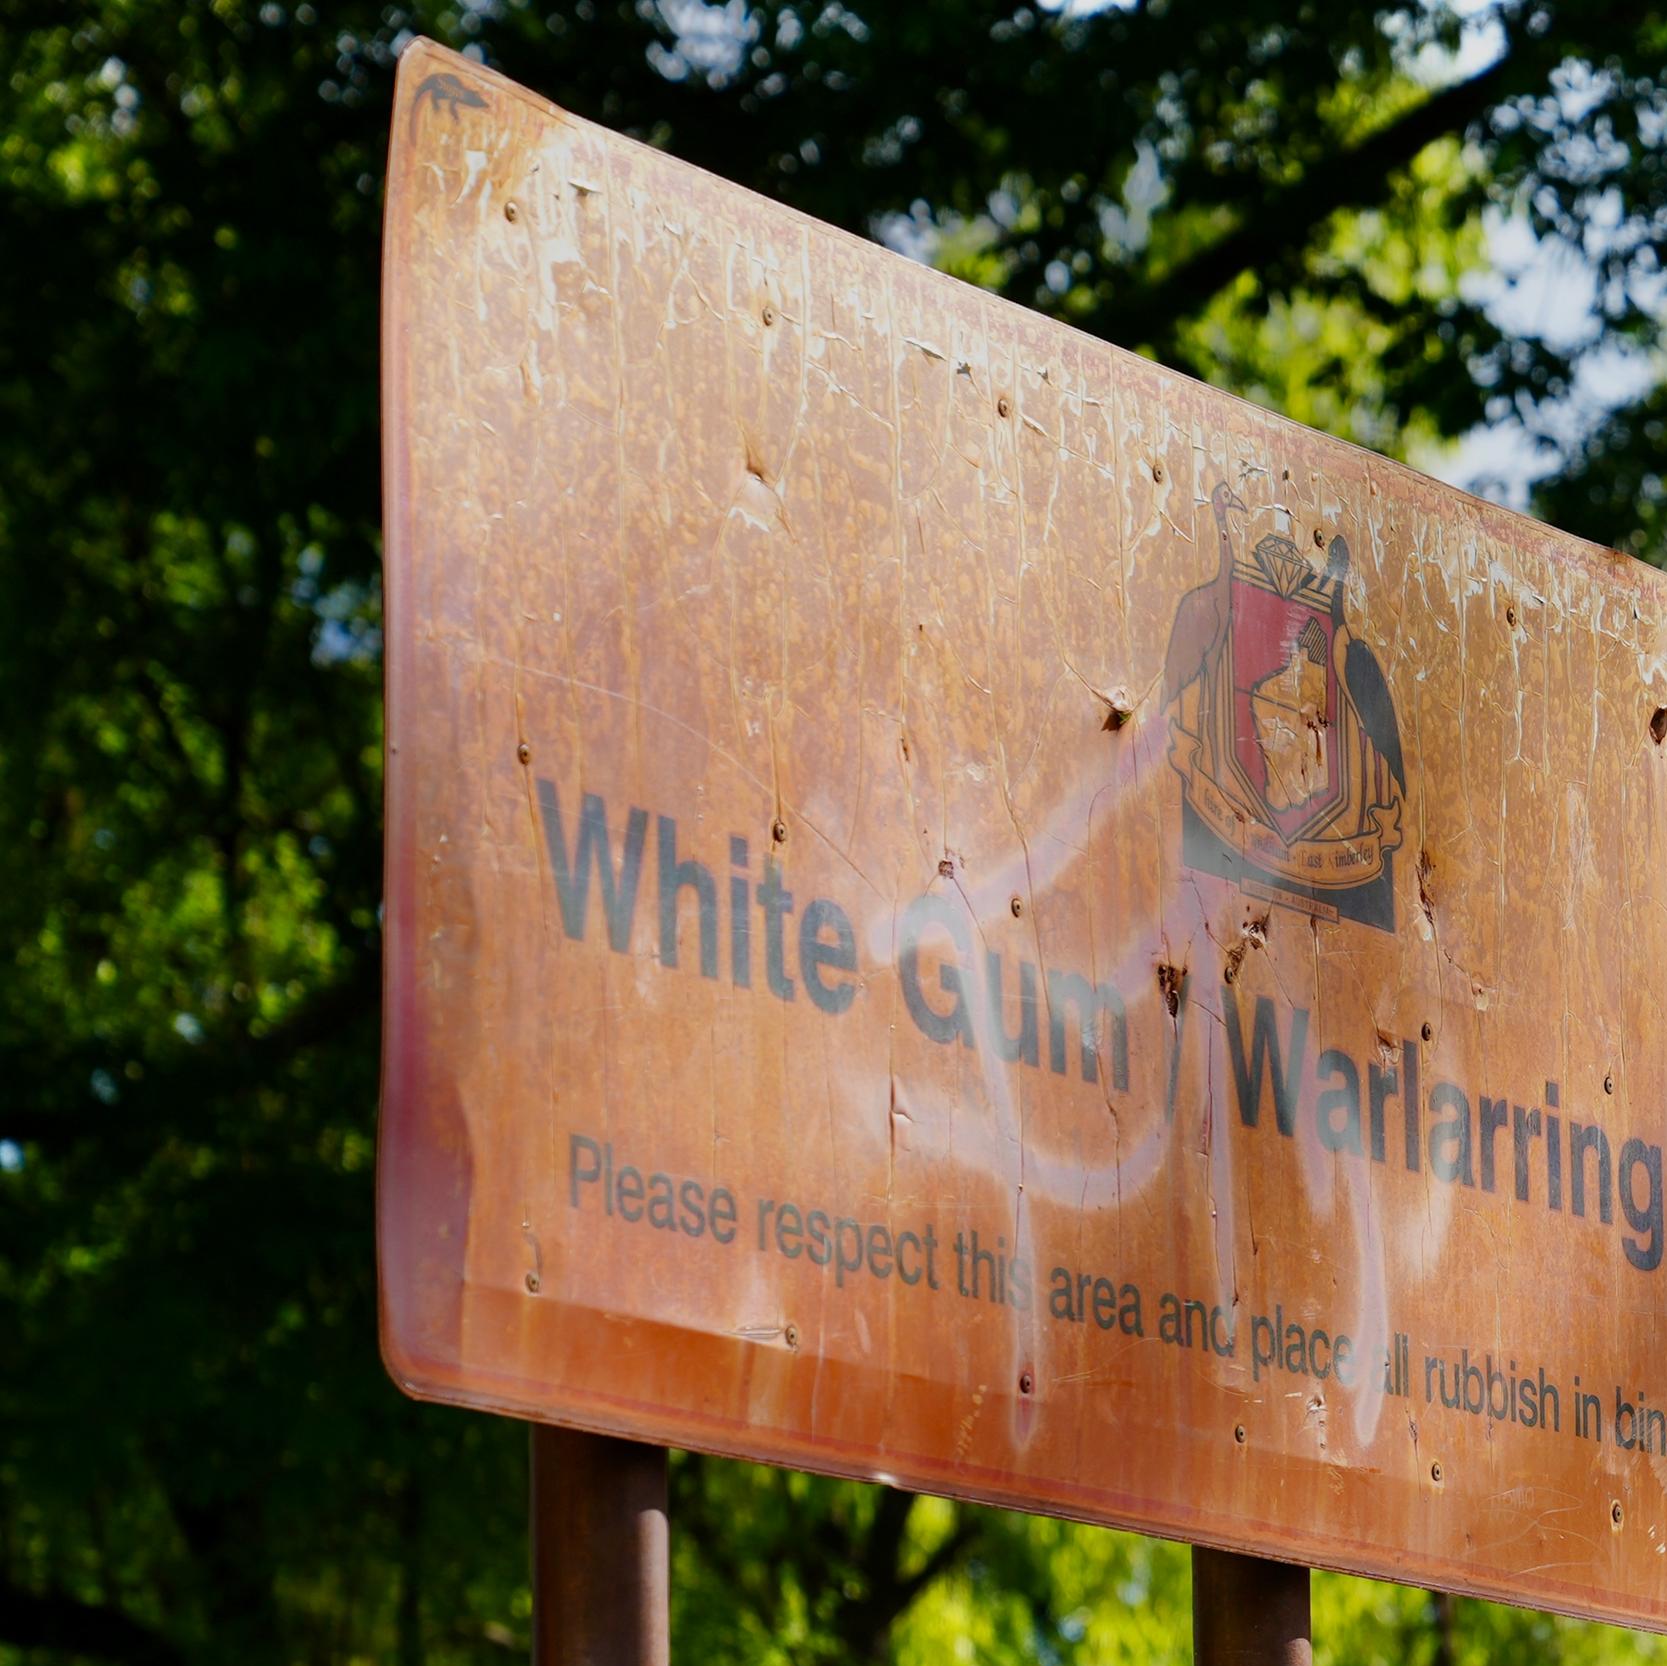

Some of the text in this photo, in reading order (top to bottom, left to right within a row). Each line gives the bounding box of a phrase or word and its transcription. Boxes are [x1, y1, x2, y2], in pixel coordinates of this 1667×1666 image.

[536, 778, 858, 1015] White
[899, 896, 1130, 1093] Gum
[1221, 984, 1664, 1271] Warlarring
[568, 1134, 737, 1244] Please
[757, 1199, 939, 1287] respect
[953, 1230, 1033, 1311] this
[1049, 1266, 1144, 1336] area
[1158, 1291, 1235, 1358] and
[1251, 1304, 1354, 1388] place
[1371, 1331, 1409, 1398] all
[1425, 1349, 1560, 1432] rubbish
[1574, 1376, 1601, 1443] in
